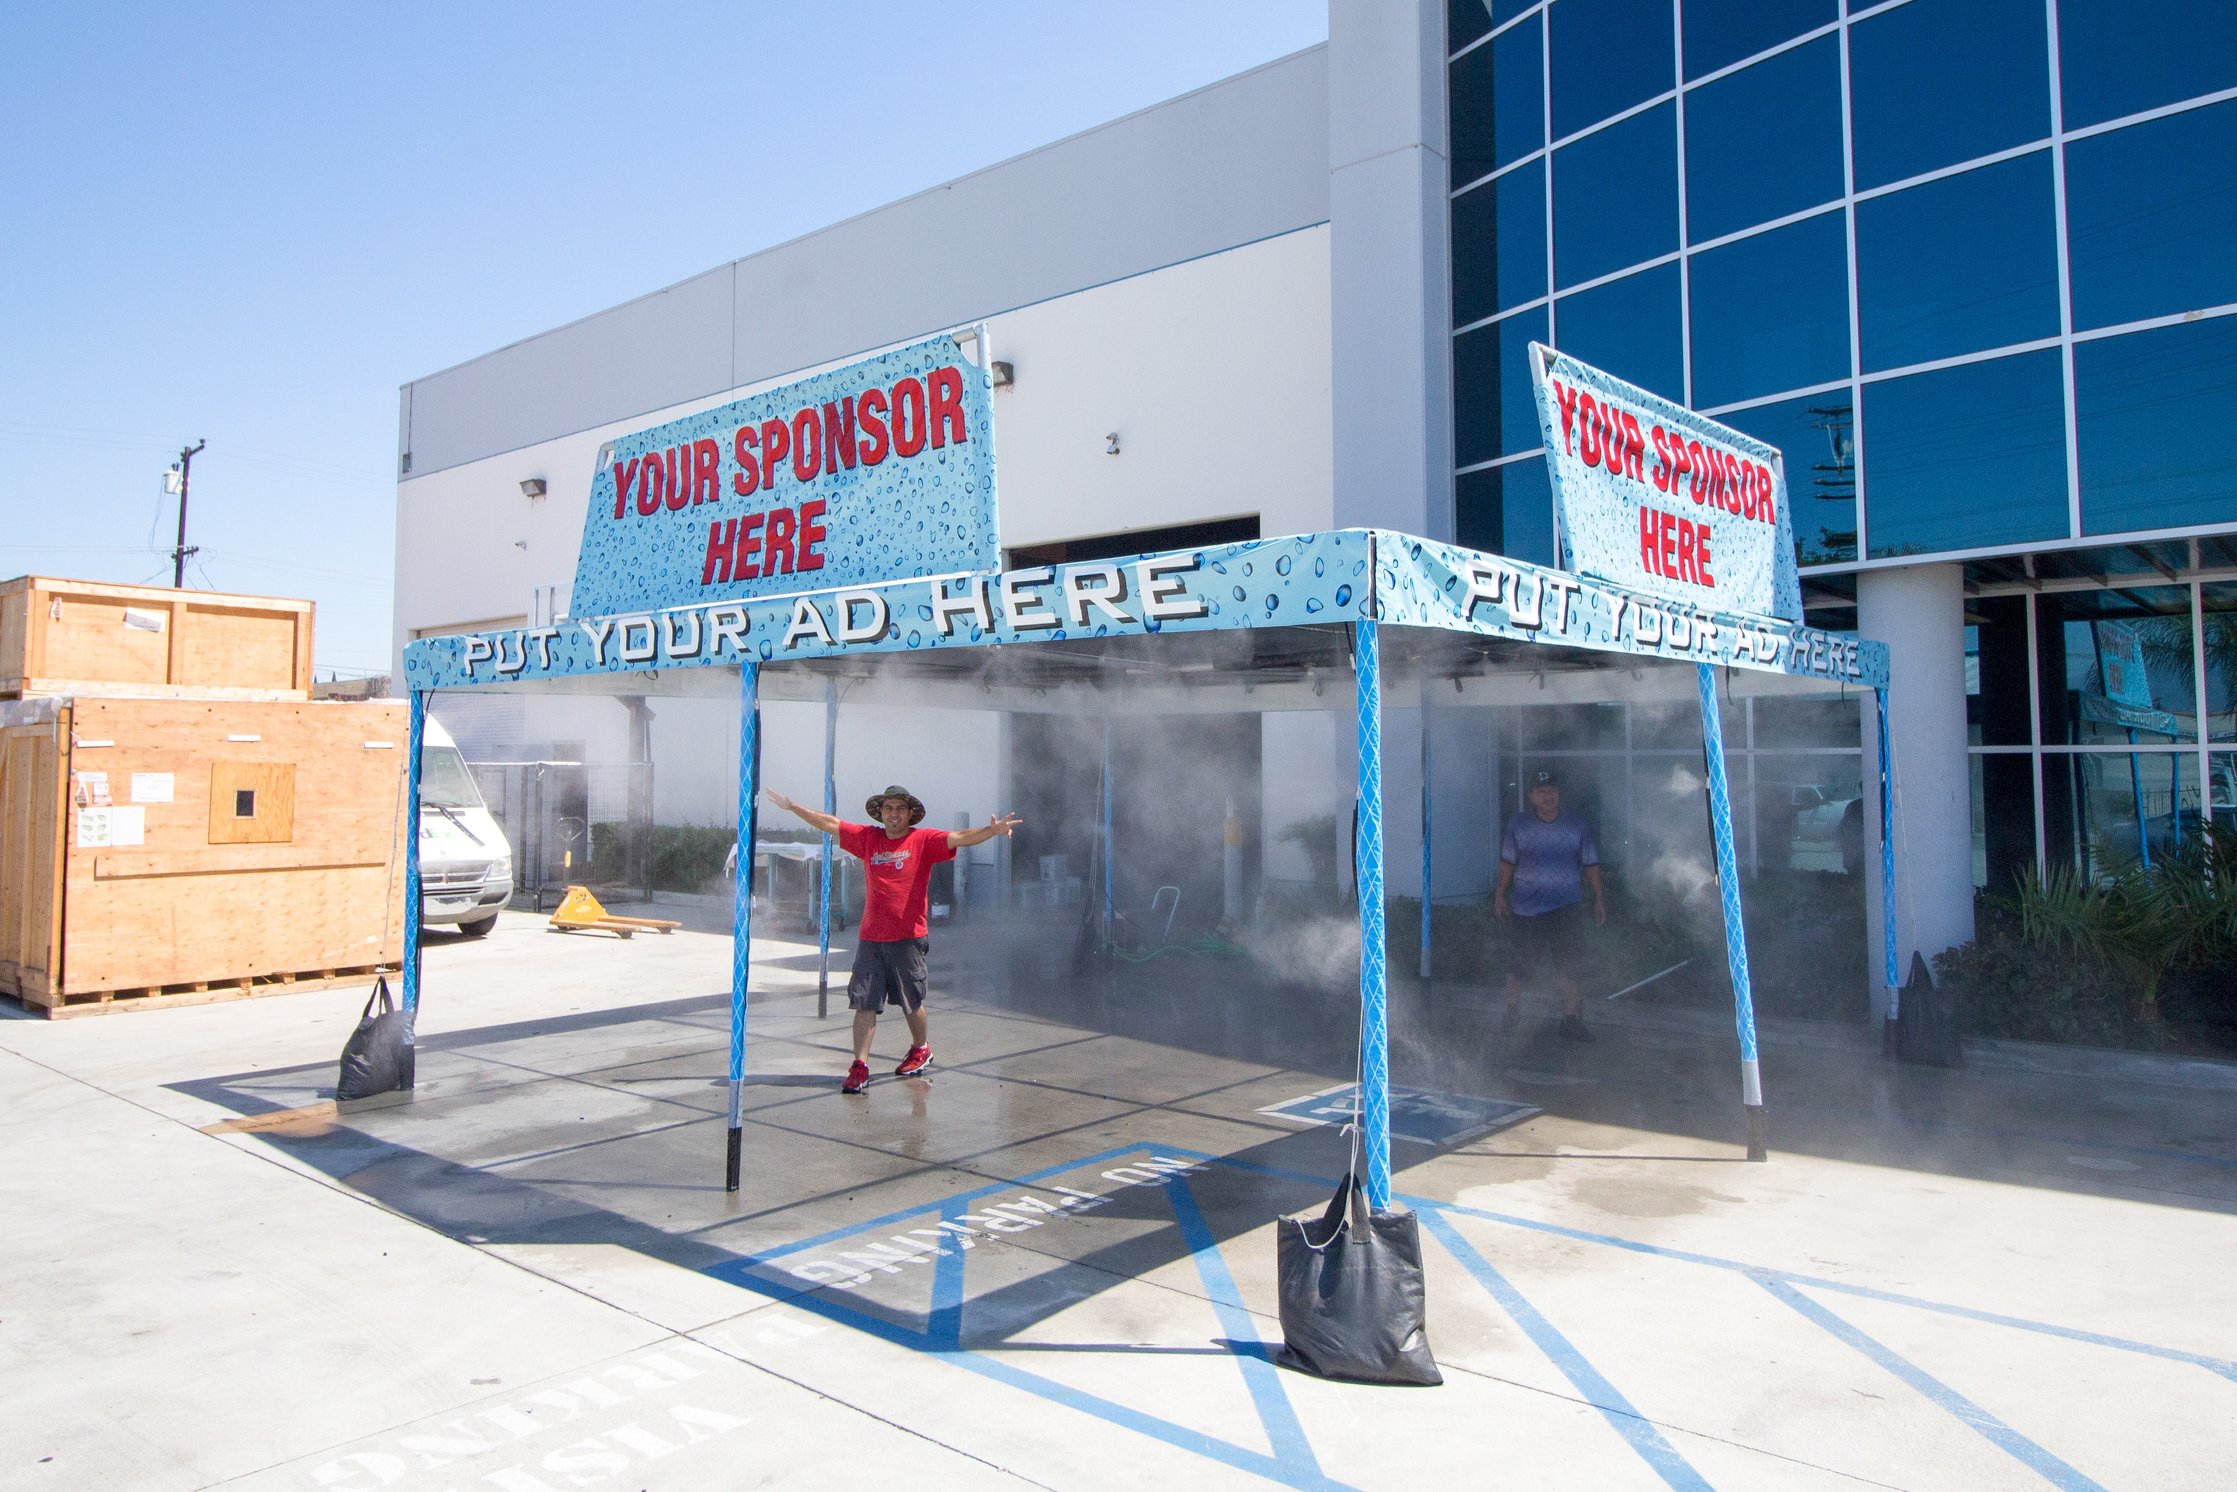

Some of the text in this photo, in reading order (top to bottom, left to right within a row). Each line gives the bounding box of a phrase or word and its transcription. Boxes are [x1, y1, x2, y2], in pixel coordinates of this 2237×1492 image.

[612, 366, 968, 519] YOUR SPONSOR
[1553, 378, 1776, 526] YOUR SPONSOR
[701, 499, 827, 585] HERE
[1639, 506, 1715, 588] HERE
[464, 556, 1209, 675] PUT YOUR AD HERE
[1460, 560, 1863, 678] PUT YOUR AD HERE
[790, 1156, 1210, 1288] NO PARKING
[311, 1312, 827, 1492] PARKING
[447, 1404, 753, 1492] VISI
